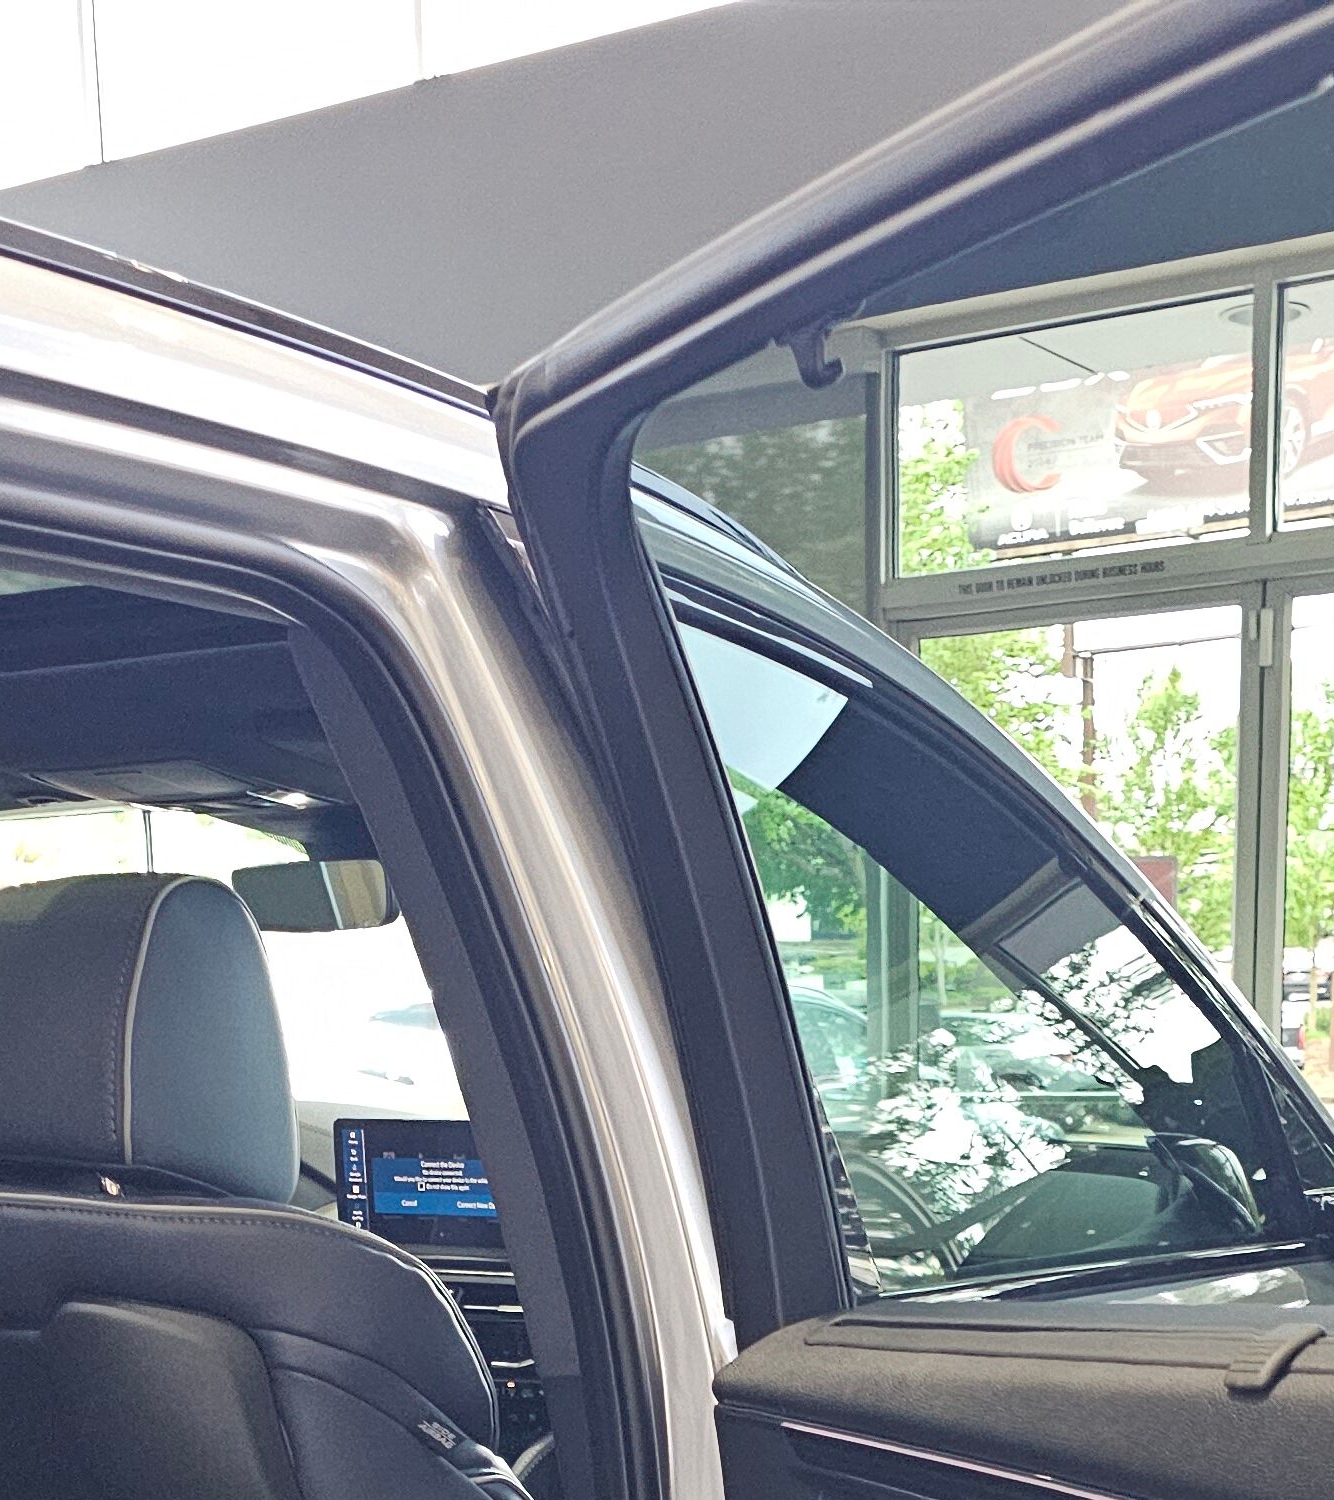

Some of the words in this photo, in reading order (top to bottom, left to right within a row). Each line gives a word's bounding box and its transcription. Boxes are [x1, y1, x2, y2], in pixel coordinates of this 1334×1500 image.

[1006, 576, 1034, 590] REMAIN
[1035, 571, 1073, 587] UNLOCKED
[1074, 567, 1100, 582] DURING
[1102, 563, 1139, 579] BUSINESS
[1140, 560, 1166, 573] HOURS
[417, 1423, 454, 1449] AIRBAG
[431, 1421, 457, 1440] SIDE
